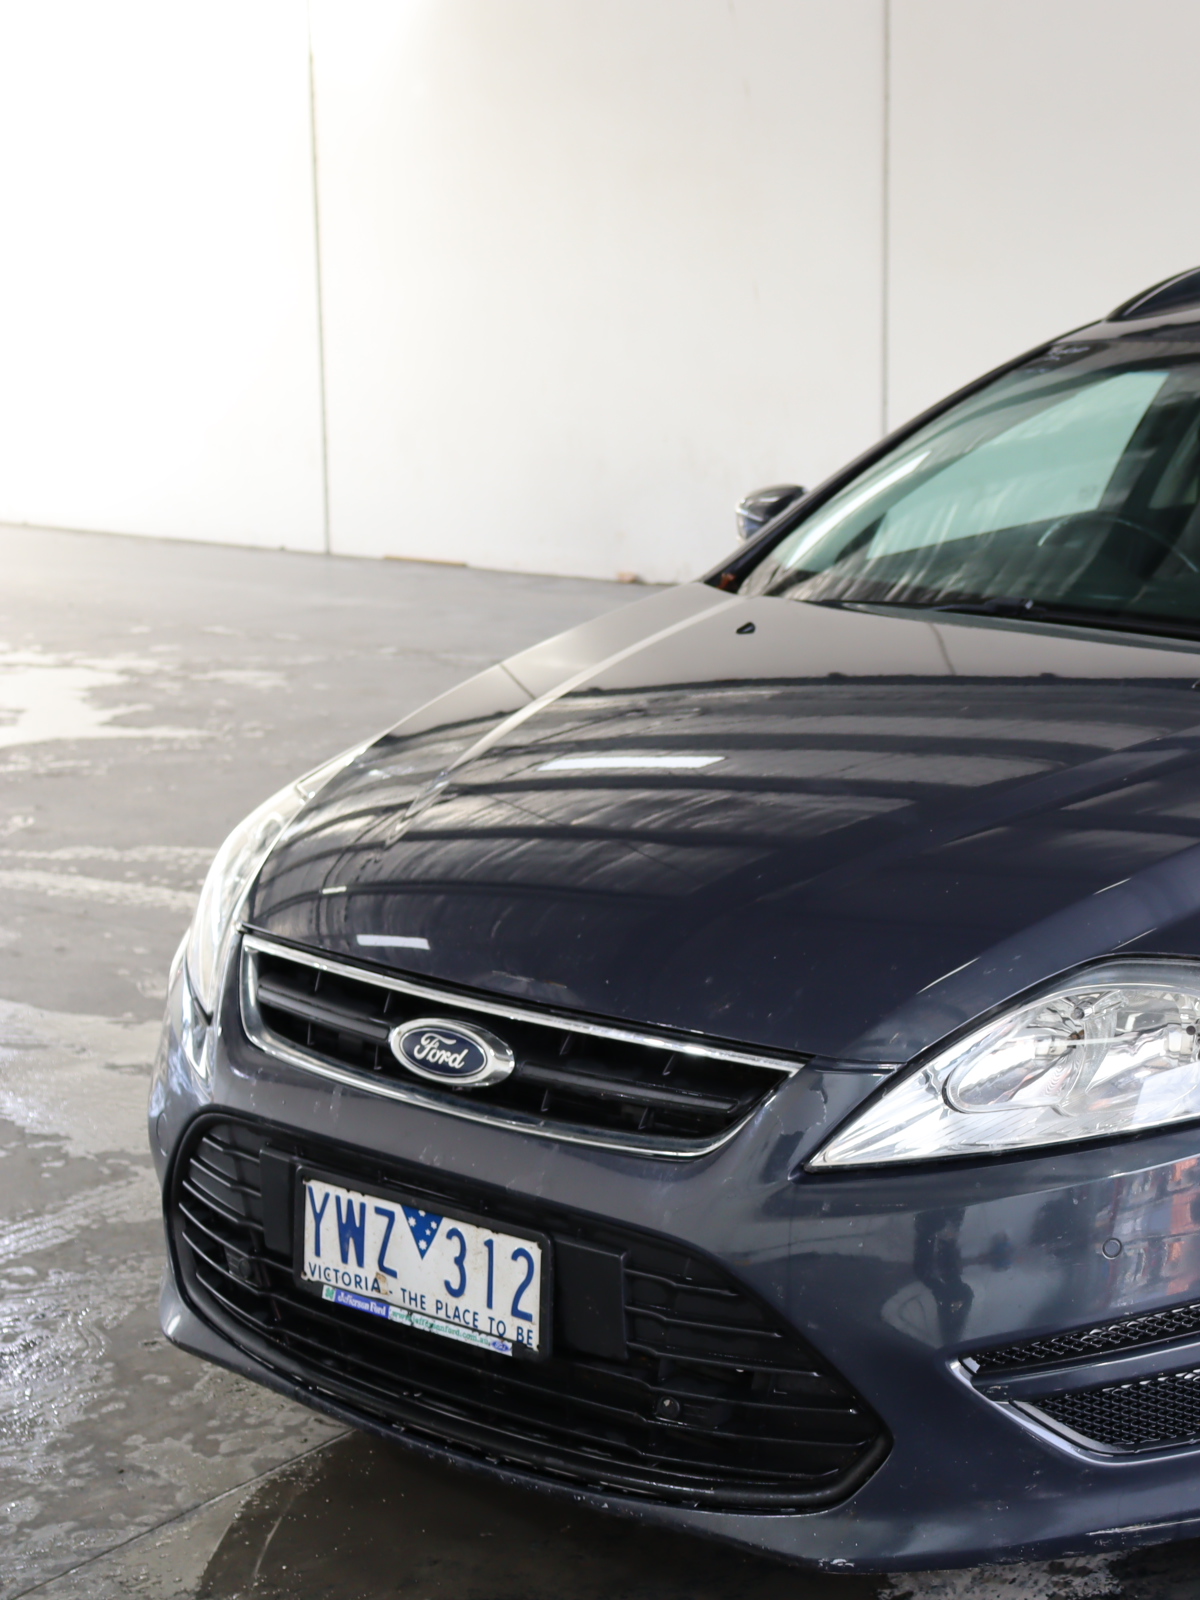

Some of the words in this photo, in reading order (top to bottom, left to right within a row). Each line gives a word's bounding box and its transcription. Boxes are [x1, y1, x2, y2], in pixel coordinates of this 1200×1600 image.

[413, 1032, 469, 1069] Ford
[307, 1185, 398, 1279] YWZ
[444, 1227, 535, 1322] 312
[308, 1261, 381, 1293] VICTORIA
[400, 1288, 426, 1311] THE
[435, 1299, 479, 1329] PLACE
[488, 1316, 506, 1338] TO
[516, 1326, 533, 1347] BE
